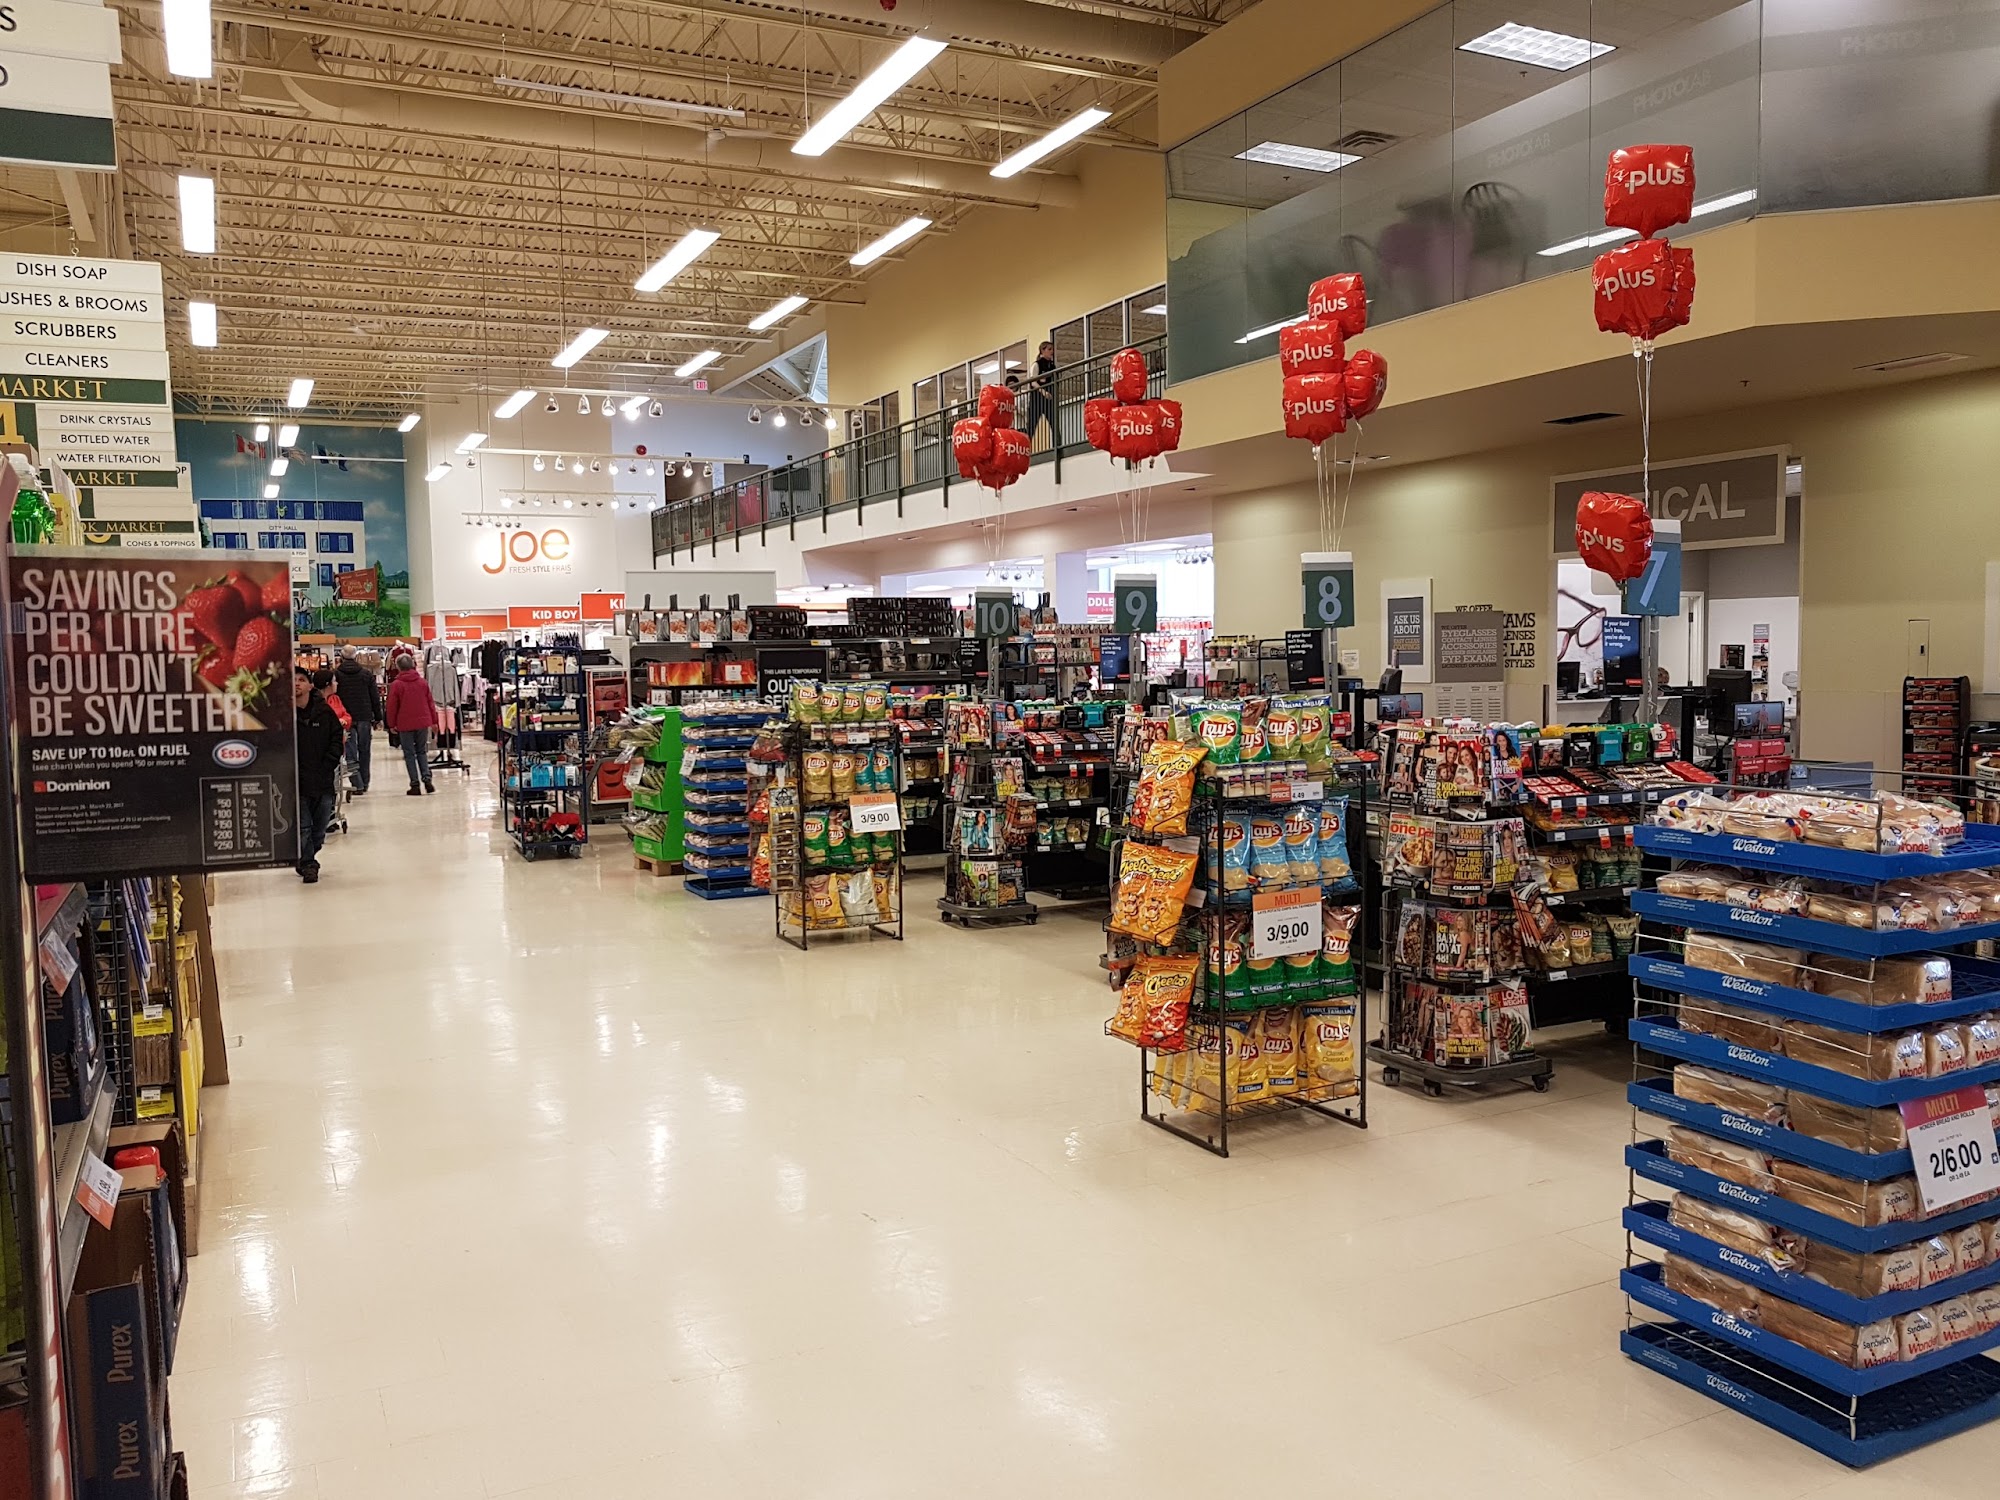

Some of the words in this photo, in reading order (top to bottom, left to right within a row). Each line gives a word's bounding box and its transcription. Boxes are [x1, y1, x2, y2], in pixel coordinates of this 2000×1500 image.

[17, 262, 56, 277] DISH
[63, 265, 107, 280] SOAP
[0, 291, 52, 307] USHES
[58, 295, 70, 308] &
[76, 296, 148, 313] BROOMS
[14, 321, 117, 340] SCRUBBERS
[25, 352, 109, 369] CLEANERS
[60, 414, 95, 425] DRINK
[98, 415, 152, 426] CRYSTALS
[60, 434, 110, 444] BOTTLED
[113, 435, 151, 445] WATER
[56, 453, 95, 463] WATER
[98, 454, 161, 464] FILTRATION
[106, 521, 166, 533] MARKET
[160, 540, 196, 548] TOPPINGS
[509, 564, 531, 574] FRESH
[532, 564, 550, 573] STYLE
[552, 564, 572, 573] FRAIS
[1639, 551, 1669, 607] 7
[22, 569, 177, 611] SAVINGS
[1318, 575, 1342, 622] 8
[532, 610, 553, 620] KID
[554, 610, 578, 620] BOY
[978, 602, 1010, 635] 10
[1125, 590, 1148, 629] 9
[1393, 614, 1409, 625] ASK
[1410, 614, 1420, 625] US
[25, 612, 92, 652] PER
[104, 612, 196, 652] LITRE
[1393, 624, 1420, 634] ABOUT
[1441, 629, 1497, 637] EYEGLASSES
[1441, 642, 1497, 650] ACCESSORIES
[1510, 642, 1535, 657] LAB
[1441, 655, 1461, 664] EYE
[1463, 654, 1497, 663] EXAMS
[1504, 659, 1536, 669] STYLES
[27, 653, 198, 695] COULDN'T
[29, 696, 74, 737] BE
[84, 693, 244, 736] SWEETER
[32, 748, 66, 761] SAVE
[69, 747, 87, 760] UP
[89, 747, 107, 759] TO
[138, 745, 157, 757] ON
[160, 744, 190, 756] FUEL
[32, 761, 49, 771] (see
[50, 760, 73, 771] chart)
[74, 760, 95, 769] when
[96, 762, 110, 770] you
[111, 759, 134, 769] spend
[46, 779, 111, 793] Dominion
[1732, 837, 1776, 856] Weston
[1275, 893, 1300, 906] MULTI
[1729, 906, 1774, 927] Weston
[1267, 921, 1309, 942] 3/9.00
[1501, 989, 1526, 1000] LOSE
[1721, 974, 1765, 997] Weston
[1727, 1045, 1770, 1067] Weston
[1925, 1093, 1960, 1118] MULTI
[1720, 1113, 1764, 1138] Weston
[1935, 1117, 1951, 1127] BREAD
[1951, 1114, 1960, 1122] AND
[1960, 1110, 1976, 1119] ROLLS
[1930, 1140, 1982, 1178] 2/6.00
[1717, 1181, 1760, 1206] Weston
[1718, 1247, 1761, 1273] Weston
[1887, 1260, 1914, 1275] Sandwich
[1711, 1311, 1753, 1340] Weston
[1862, 1336, 1892, 1350] Sandwich
[106, 1322, 134, 1384] Purex
[1706, 1373, 1747, 1403] Weston
[113, 1420, 141, 1480] Purex
